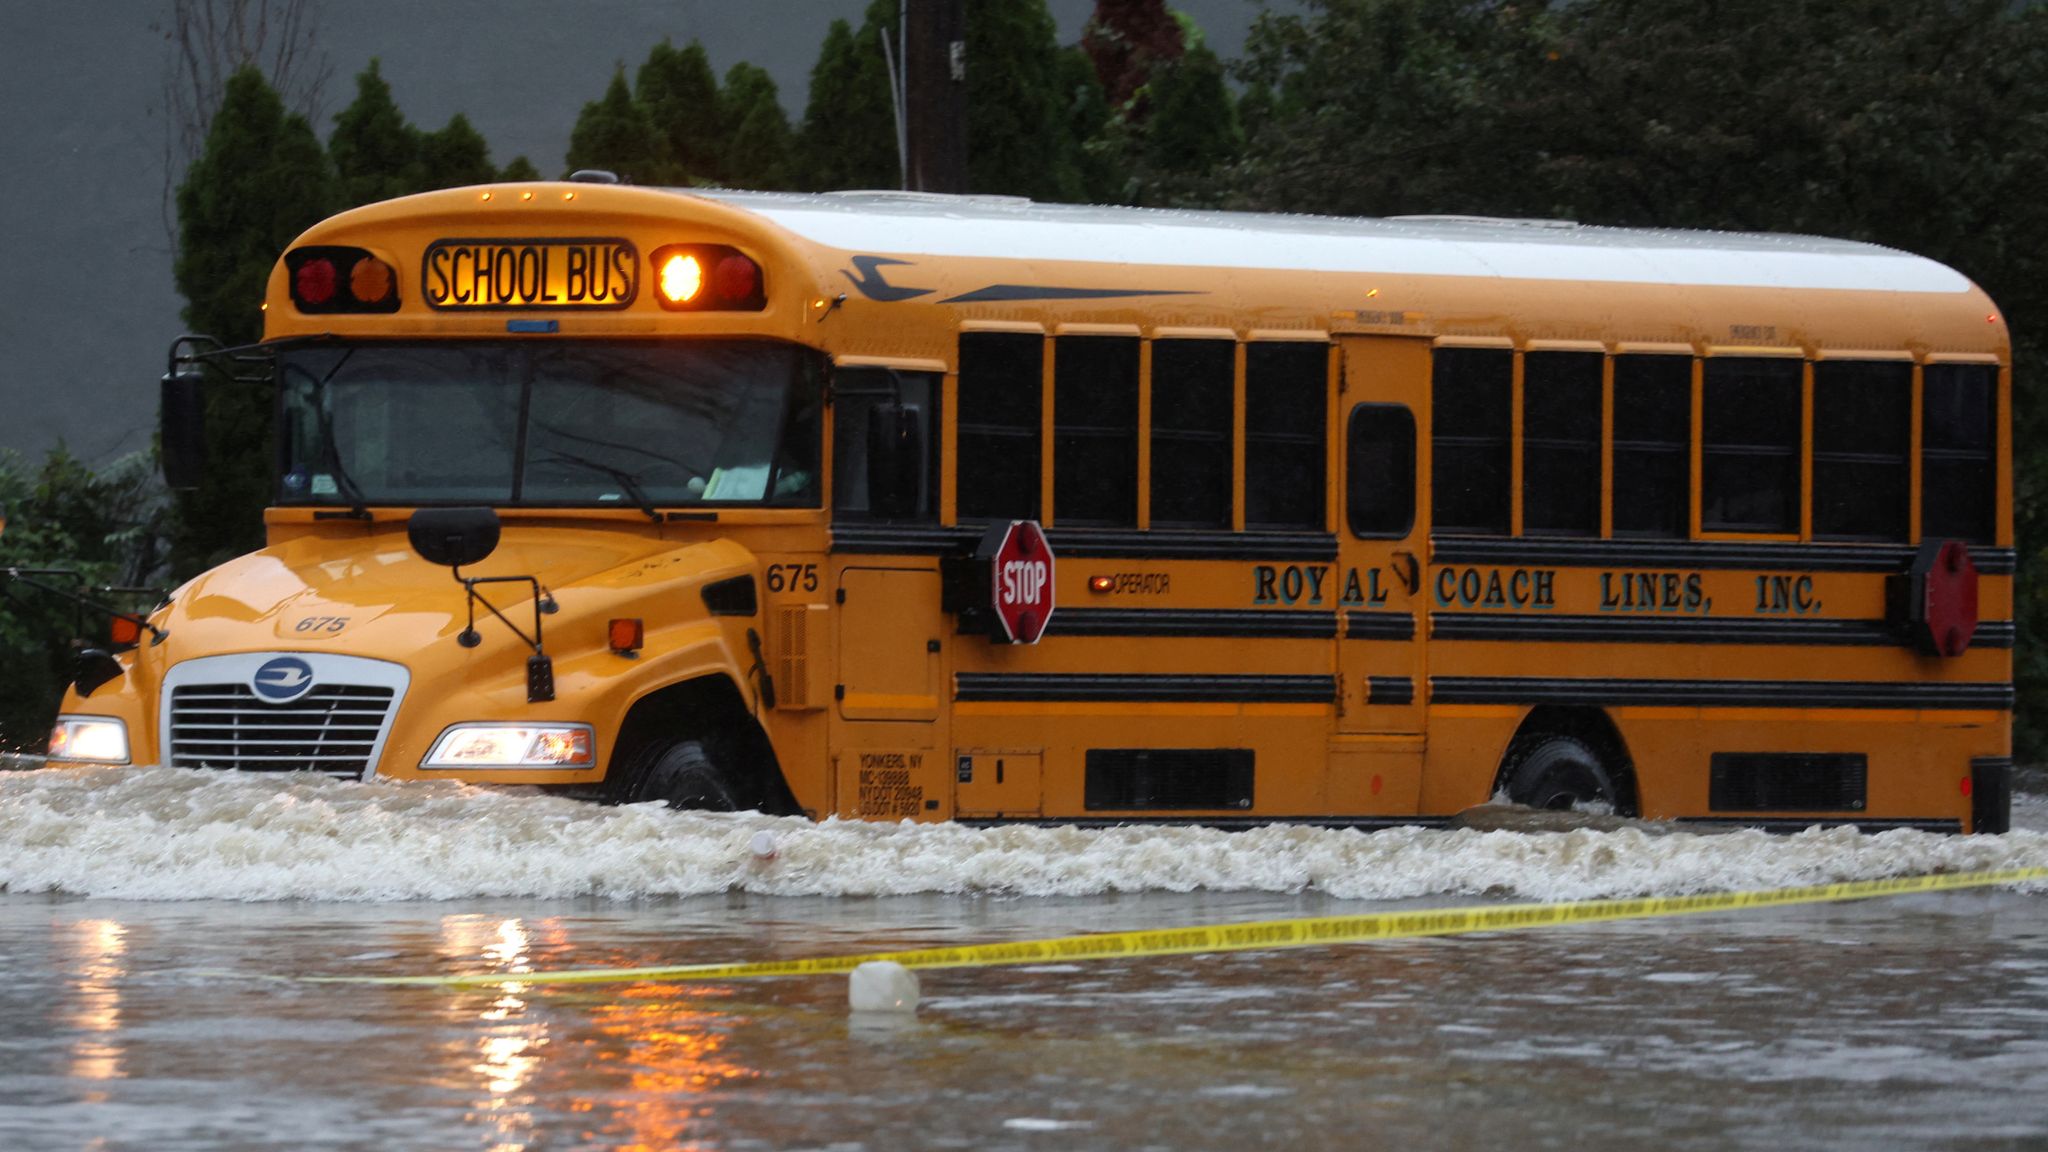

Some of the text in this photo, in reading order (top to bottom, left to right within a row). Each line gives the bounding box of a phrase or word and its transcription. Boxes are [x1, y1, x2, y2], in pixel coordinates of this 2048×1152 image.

[430, 246, 632, 303] SCHOOL BUS
[767, 563, 819, 593] 675
[1003, 560, 1047, 605] STOP
[1112, 573, 1171, 594] OPERATOR
[1434, 567, 1556, 609] COACH
[1600, 572, 1713, 616] LINES,
[1755, 575, 1823, 614] INC.
[295, 616, 352, 632] 675
[909, 754, 923, 769] NY
